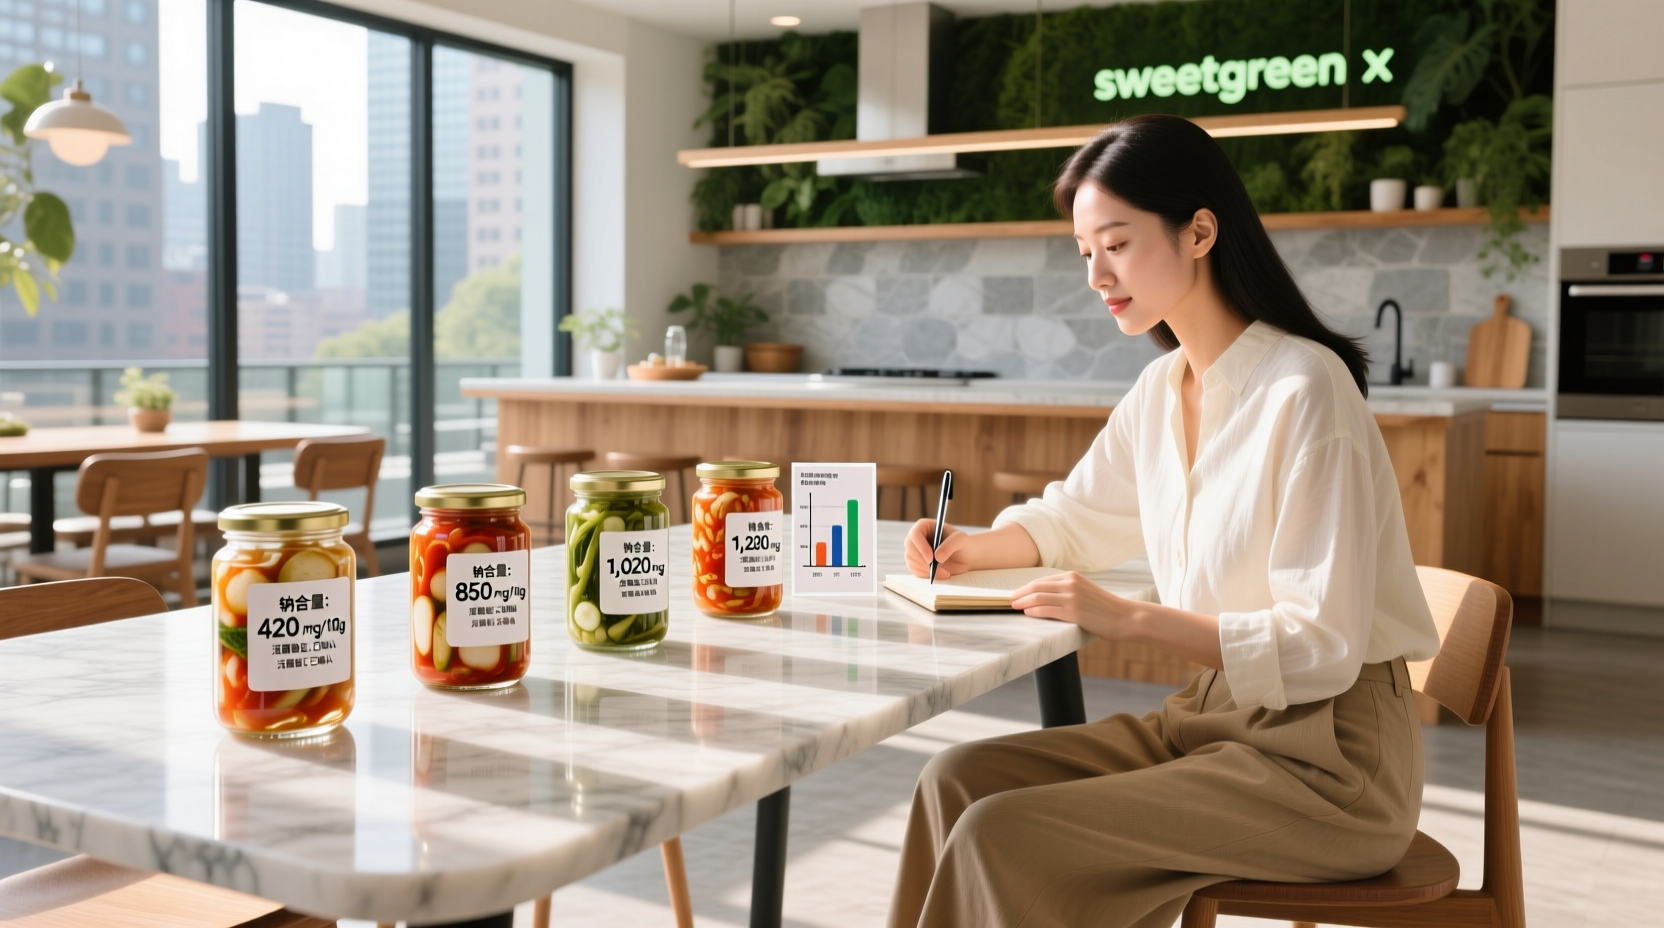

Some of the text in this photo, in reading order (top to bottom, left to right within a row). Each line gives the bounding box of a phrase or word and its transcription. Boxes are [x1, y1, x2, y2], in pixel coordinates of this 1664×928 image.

[1093, 52, 1347, 104] sweetgreen
[607, 556, 651, 578] 1,020
[455, 582, 492, 602] 850
[257, 616, 300, 639] 420
